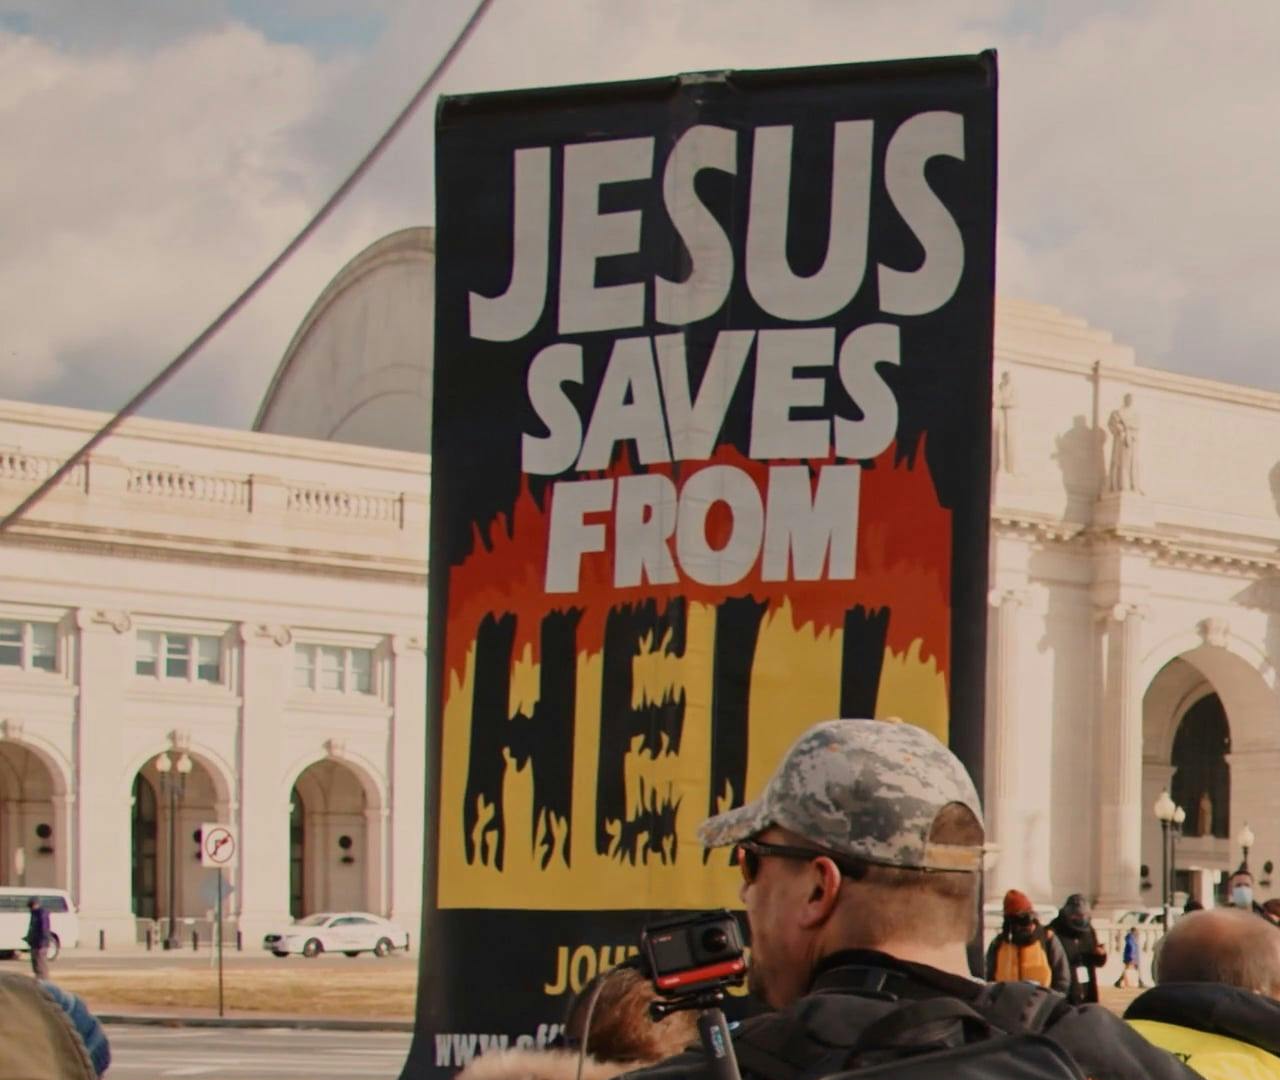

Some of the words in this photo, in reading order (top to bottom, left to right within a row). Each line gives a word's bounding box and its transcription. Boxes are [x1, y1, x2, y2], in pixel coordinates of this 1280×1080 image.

[469, 111, 965, 342] JESUS
[521, 323, 900, 475] SAVES
[544, 464, 861, 593] FROM
